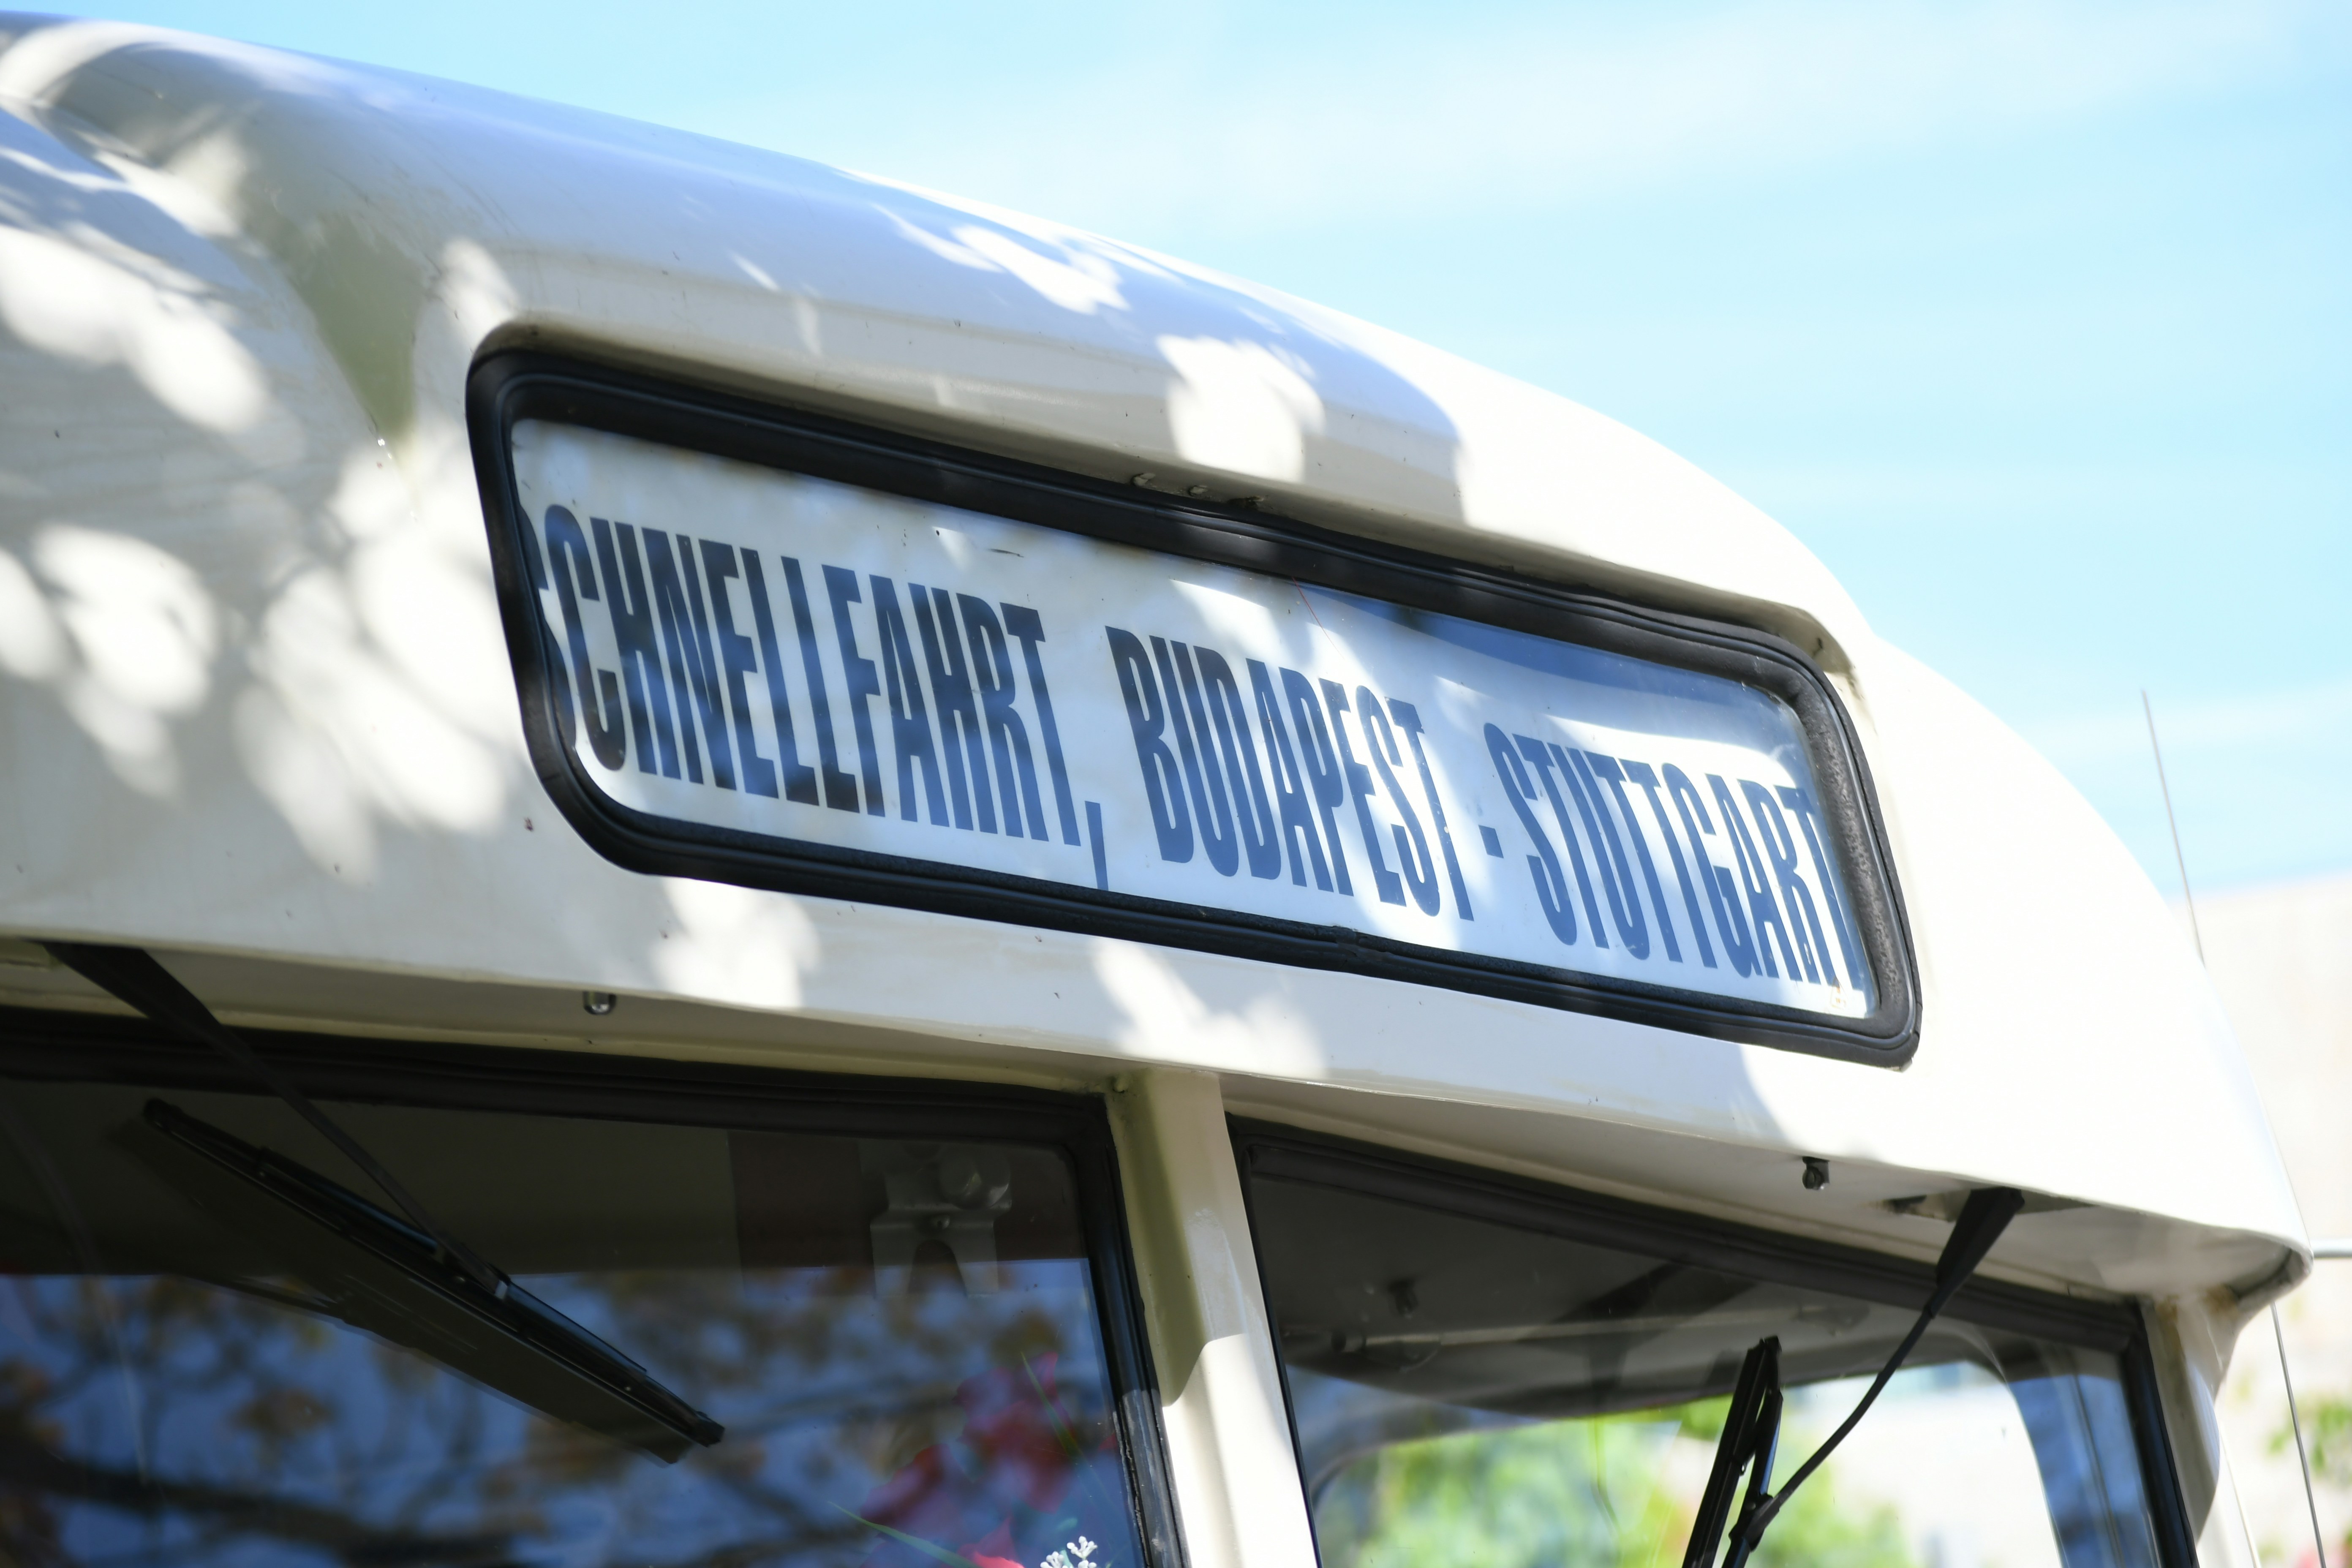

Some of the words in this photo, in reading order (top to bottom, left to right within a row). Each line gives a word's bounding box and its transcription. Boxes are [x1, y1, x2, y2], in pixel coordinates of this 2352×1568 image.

[1105, 626, 1474, 921] BUDAPEST
[1478, 825, 1504, 858] -
[1484, 723, 1864, 991] STUTTGART
